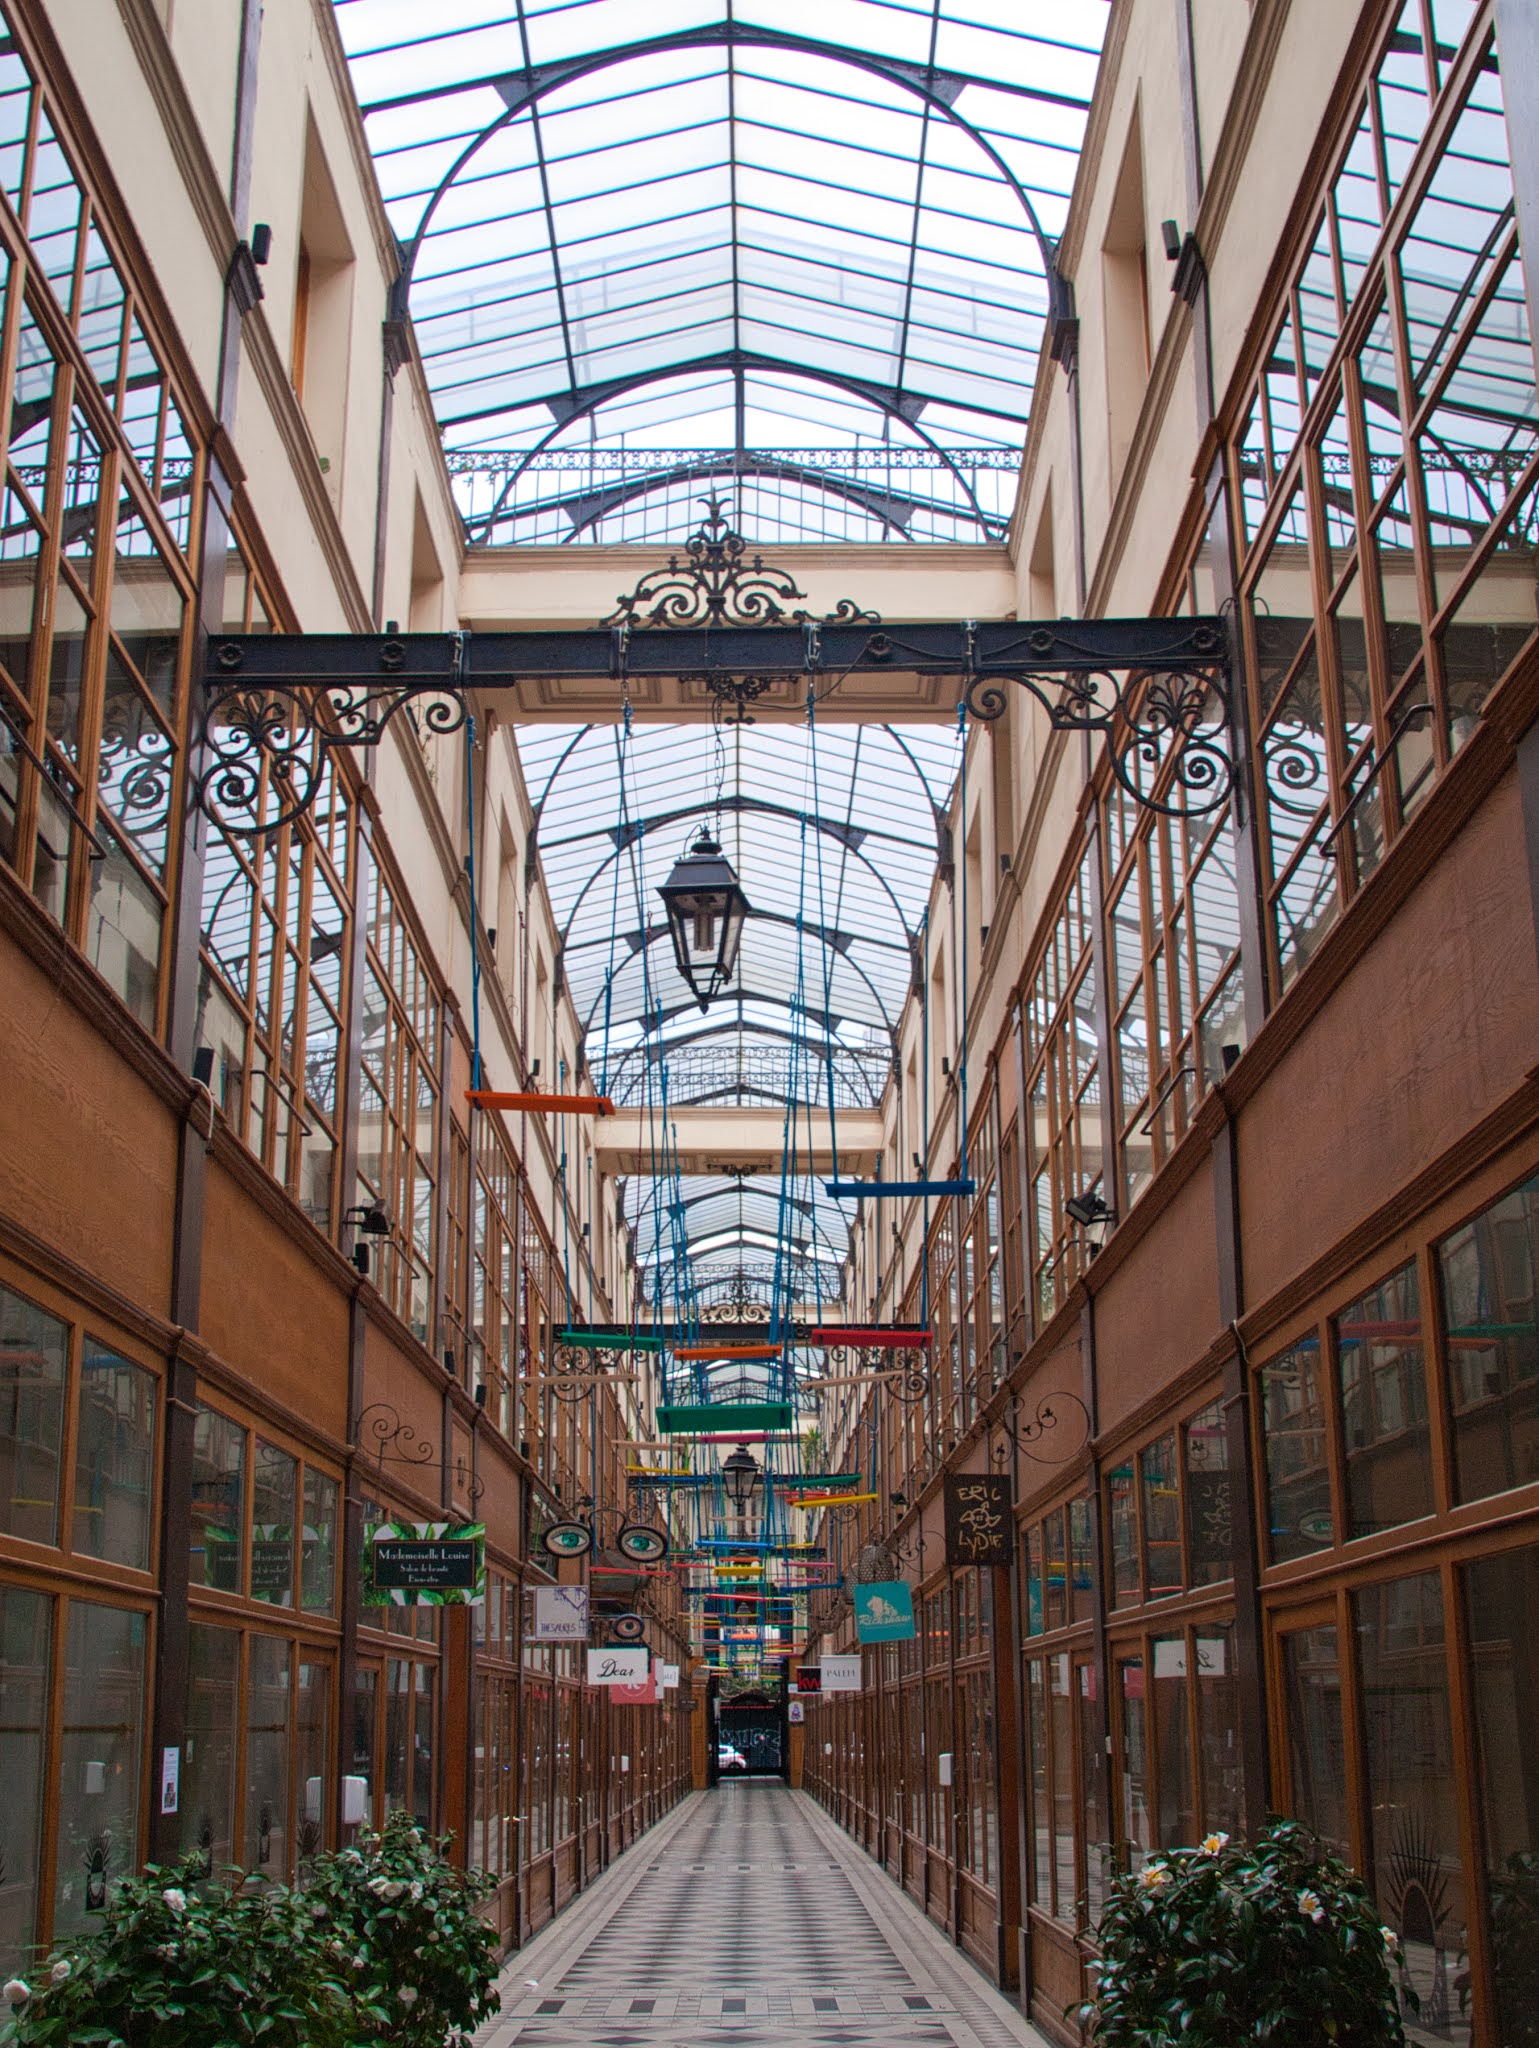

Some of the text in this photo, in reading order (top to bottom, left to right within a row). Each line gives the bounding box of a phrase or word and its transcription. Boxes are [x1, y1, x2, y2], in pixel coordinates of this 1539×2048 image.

[378, 1548, 470, 1560] Mademoiselle Louise
[597, 1658, 635, 1678] Dear
